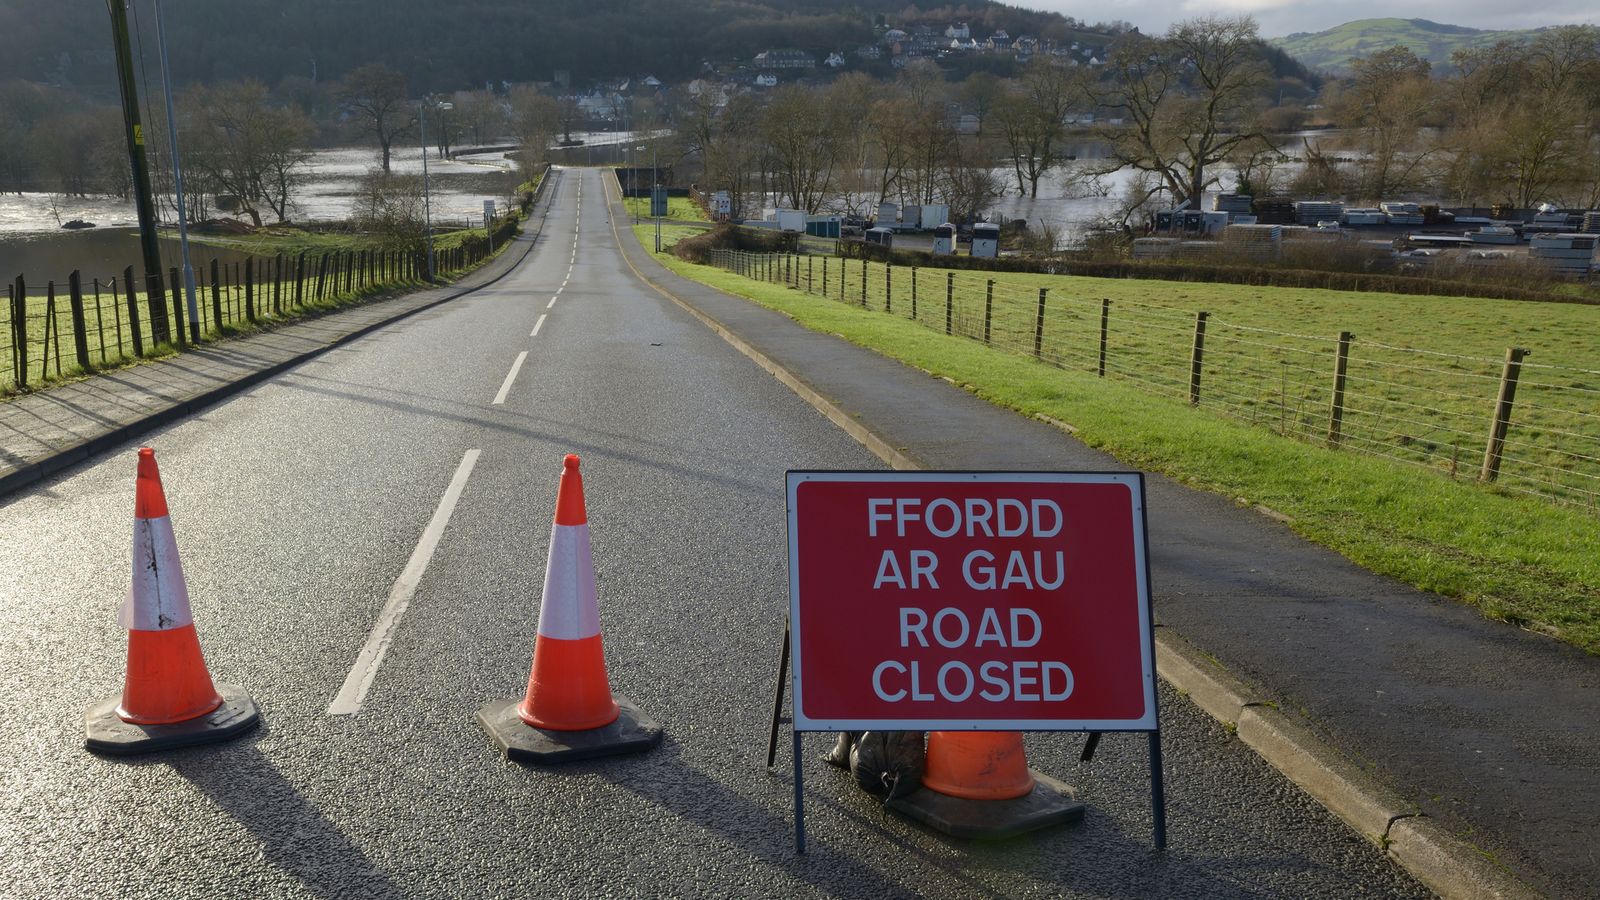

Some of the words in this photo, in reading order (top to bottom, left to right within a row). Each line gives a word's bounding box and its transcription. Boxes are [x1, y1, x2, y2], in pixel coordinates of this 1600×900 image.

[868, 498, 1063, 538] FFORDD
[873, 549, 940, 589] AR
[962, 549, 1065, 590] GAU
[899, 607, 1042, 648] ROAD
[872, 660, 1075, 703] CLOSED
